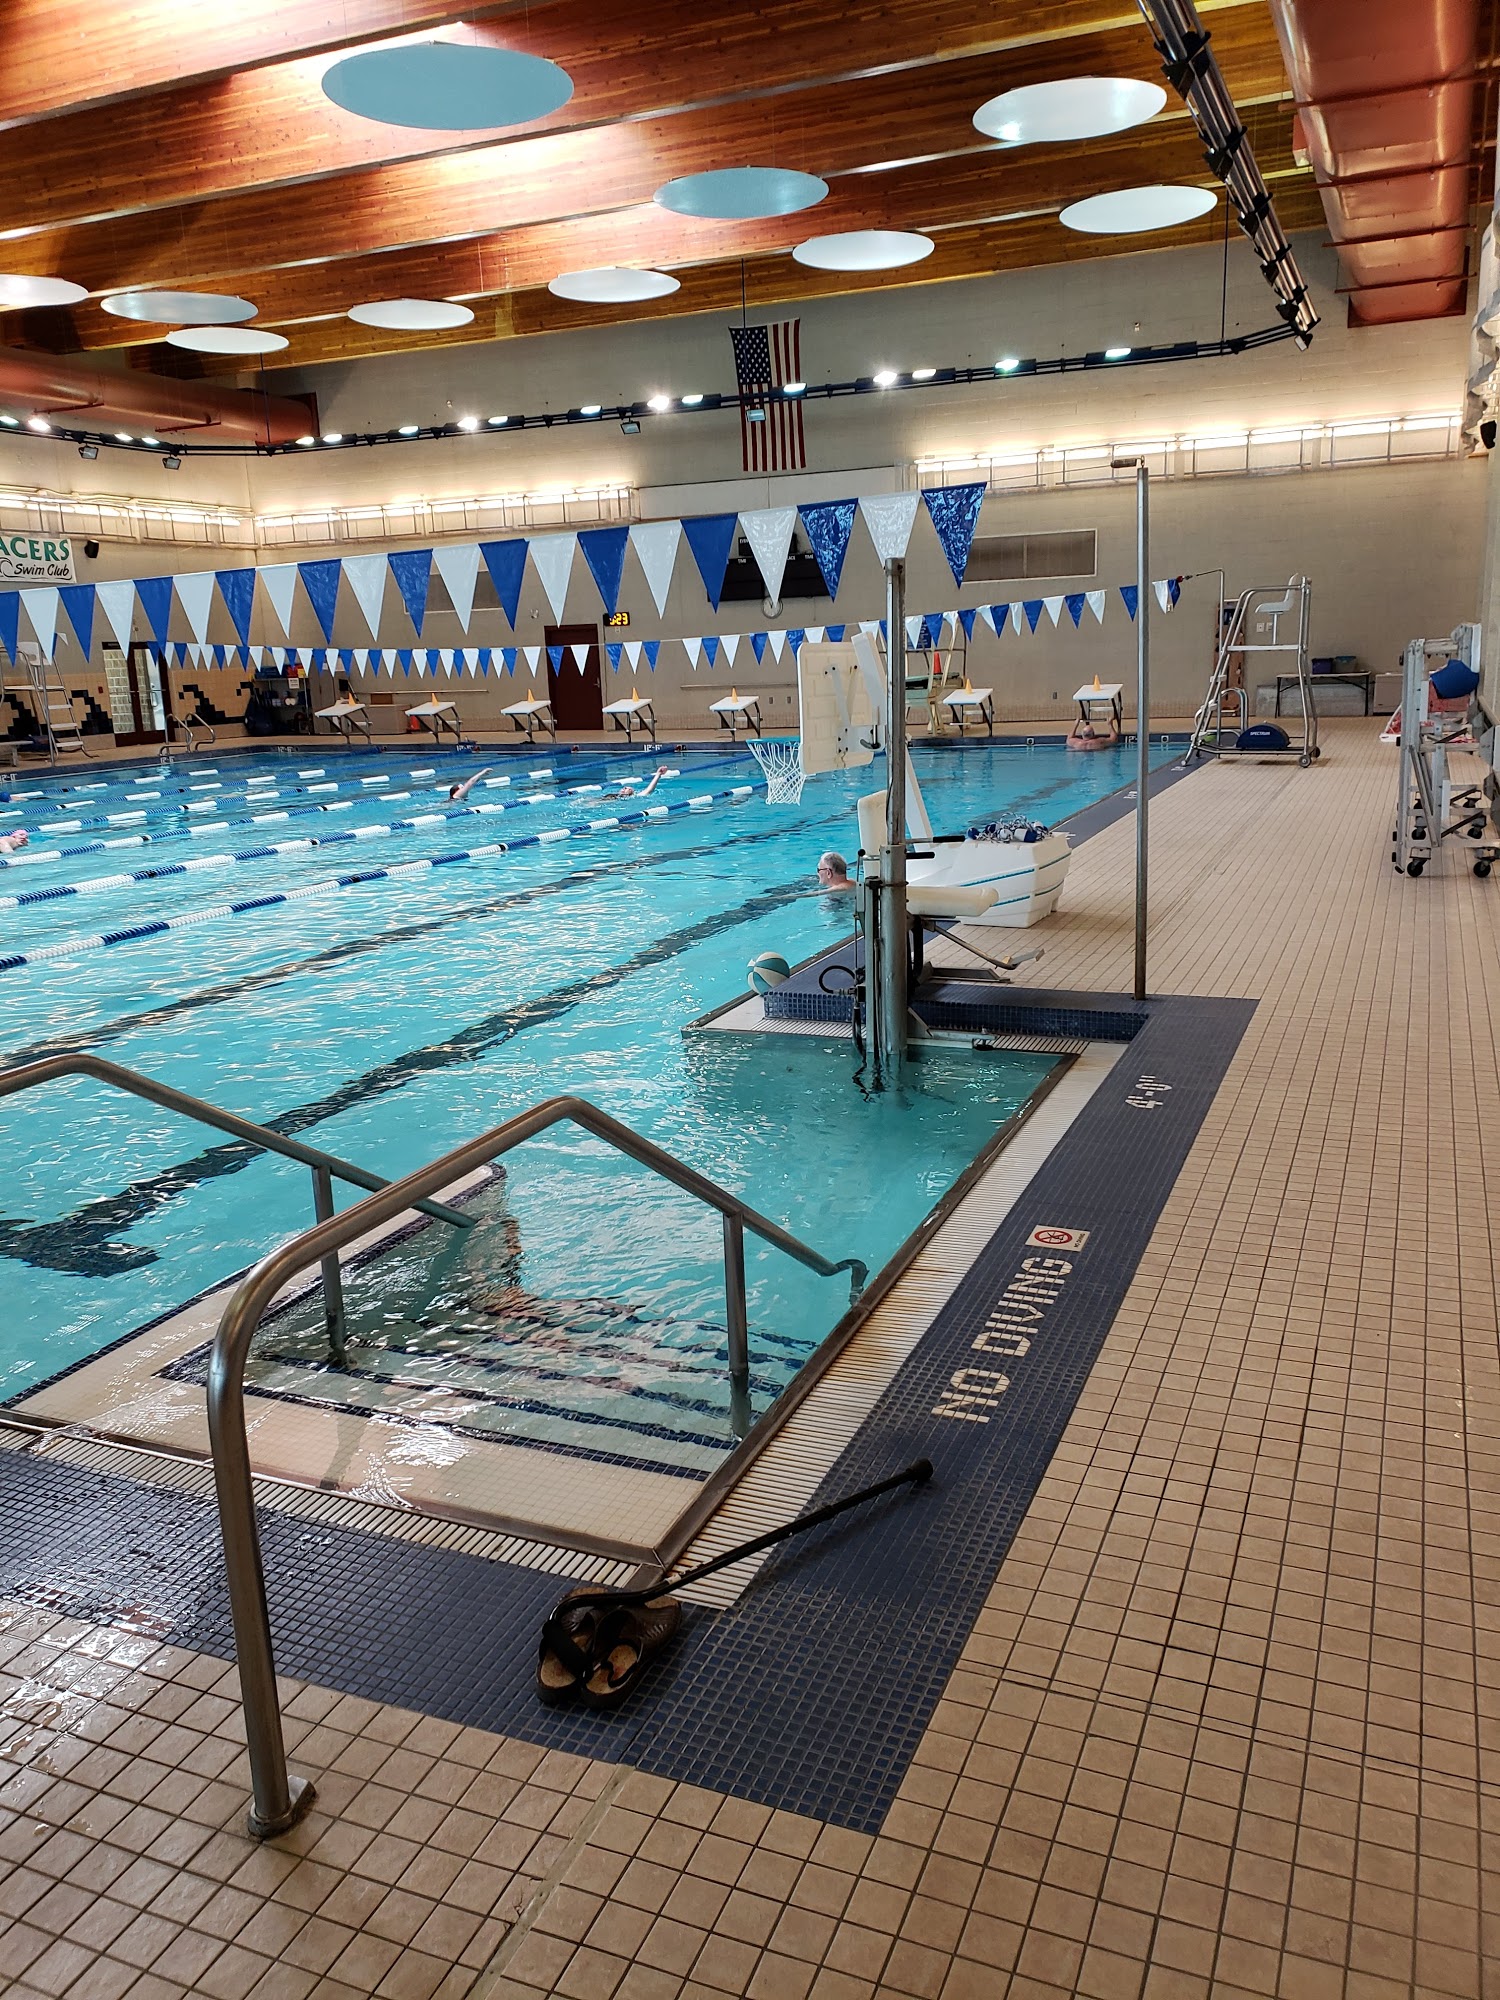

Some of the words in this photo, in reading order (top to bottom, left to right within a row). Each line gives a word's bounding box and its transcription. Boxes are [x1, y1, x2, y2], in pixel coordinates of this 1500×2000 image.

[14, 563, 45, 576] Swim
[47, 563, 70, 577] Club
[970, 1257, 1074, 1357] DIVING
[930, 1368, 1011, 1424] NO
